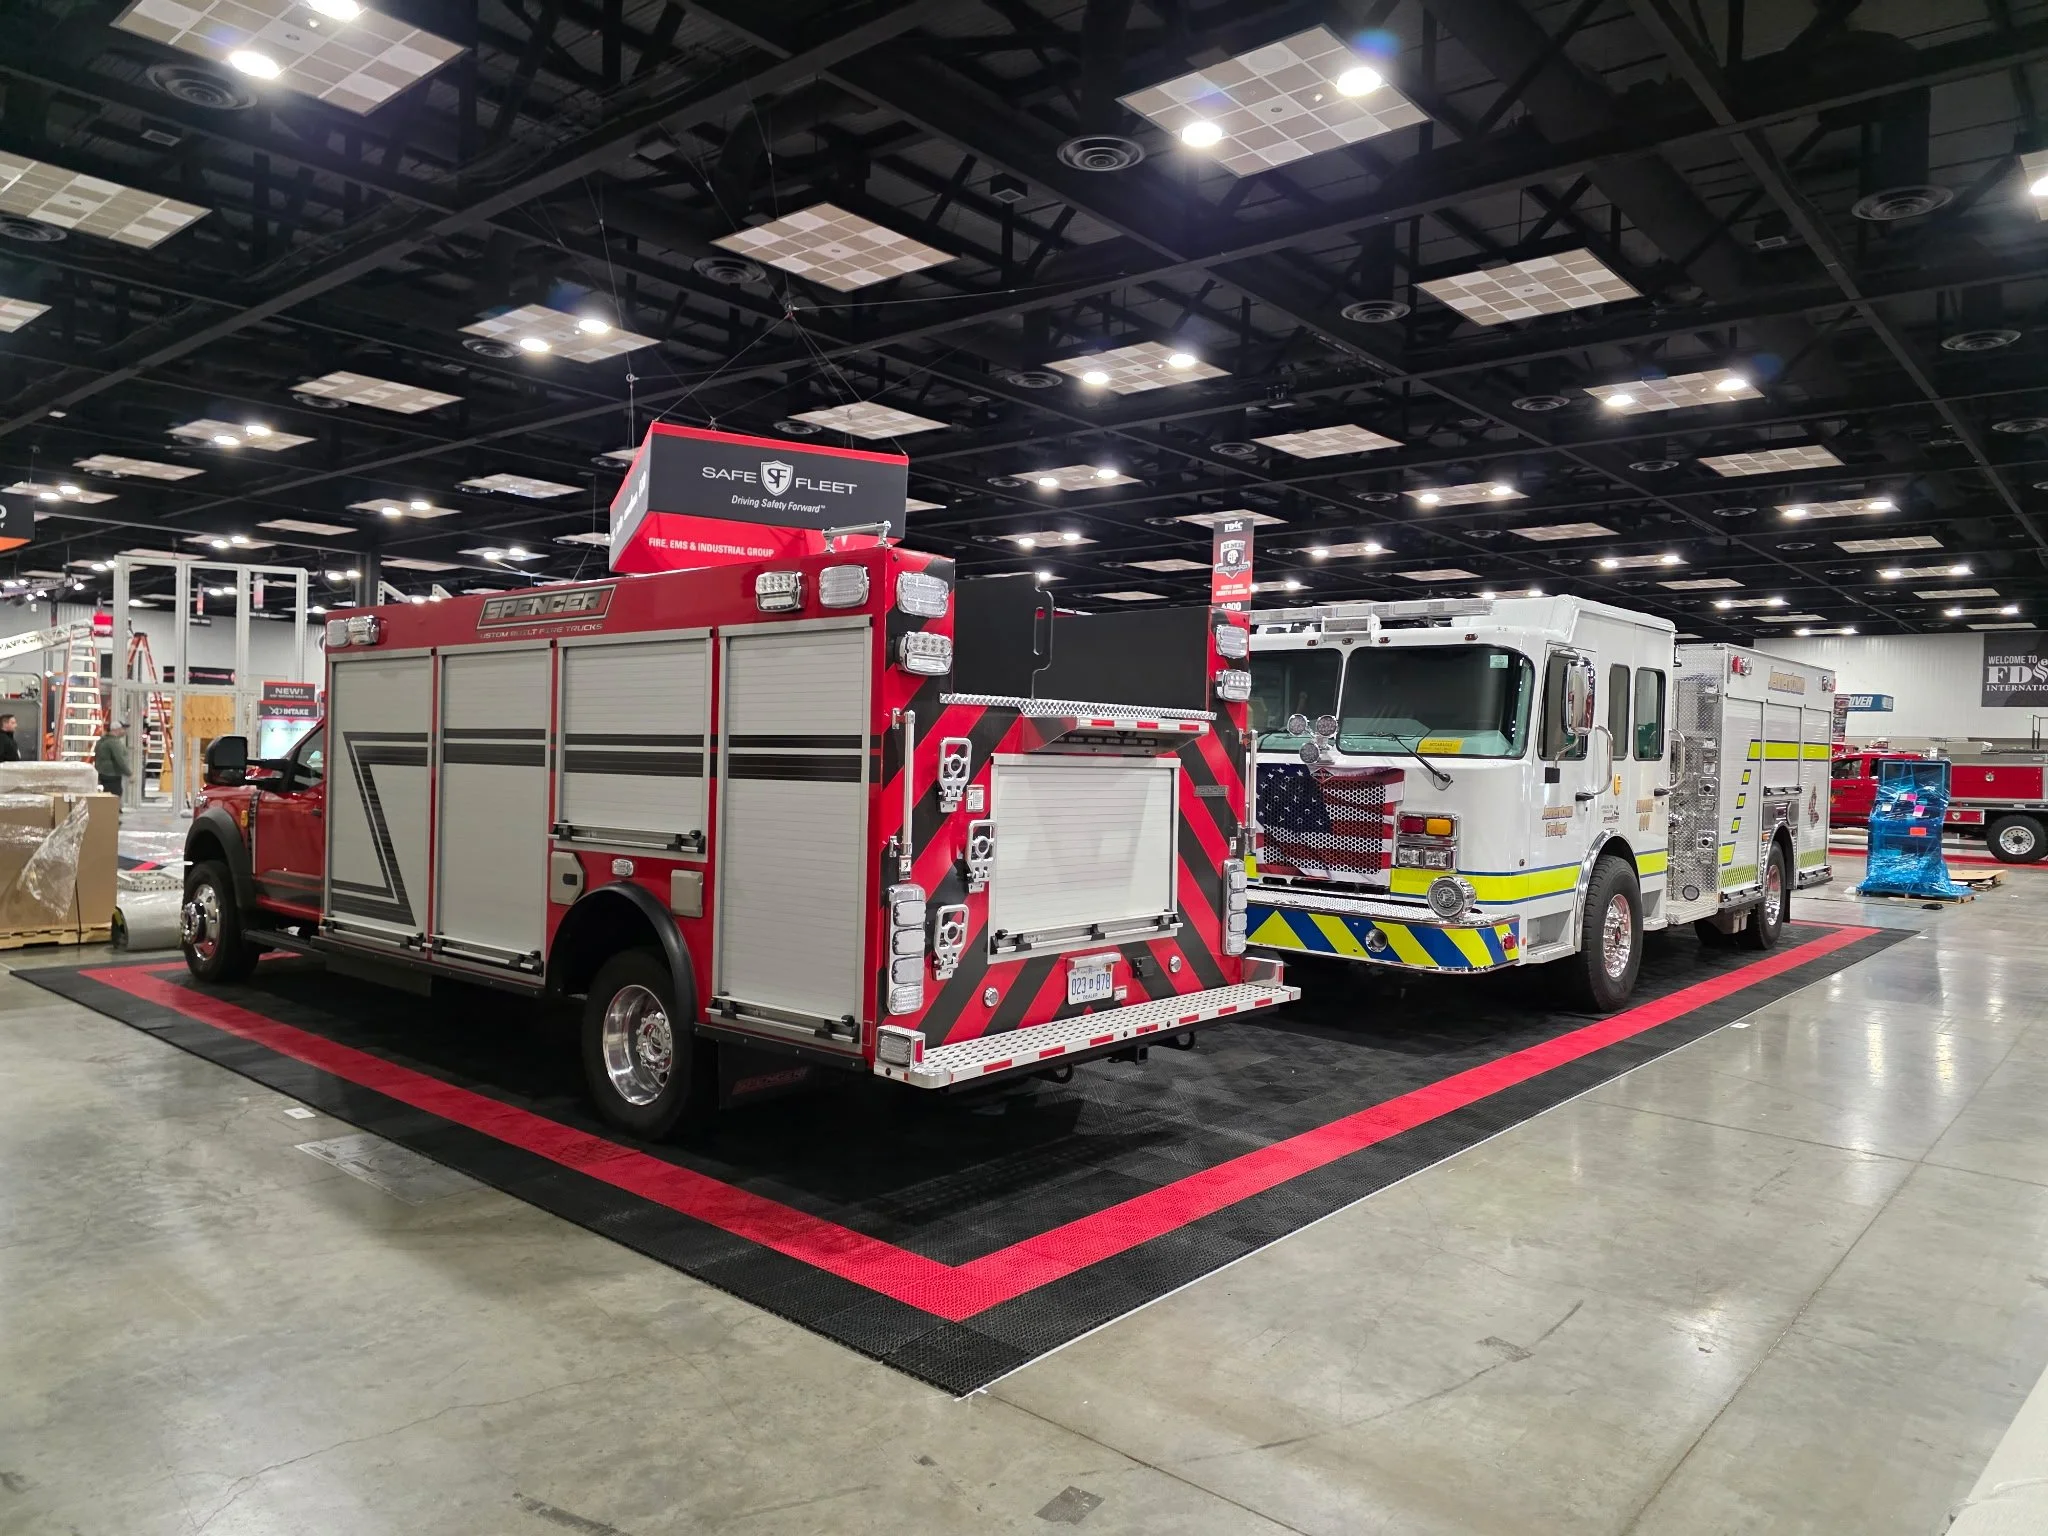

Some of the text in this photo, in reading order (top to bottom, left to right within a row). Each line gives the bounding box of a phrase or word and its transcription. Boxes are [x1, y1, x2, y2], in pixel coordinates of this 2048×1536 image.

[702, 467, 858, 495] SAFE FLEET
[731, 495, 760, 509] Driving
[761, 498, 787, 511] Safety
[648, 537, 775, 558] FIRE, EMS & INDUSTRIAL GROUP
[484, 592, 601, 619] SPENCER
[479, 631, 509, 639] USTOM
[566, 623, 603, 632] TRUCKS
[1988, 655, 2038, 664] WELCOME TO
[275, 687, 304, 695] NEW!
[1071, 976, 1087, 996] 023
[1096, 972, 1111, 991] 878
